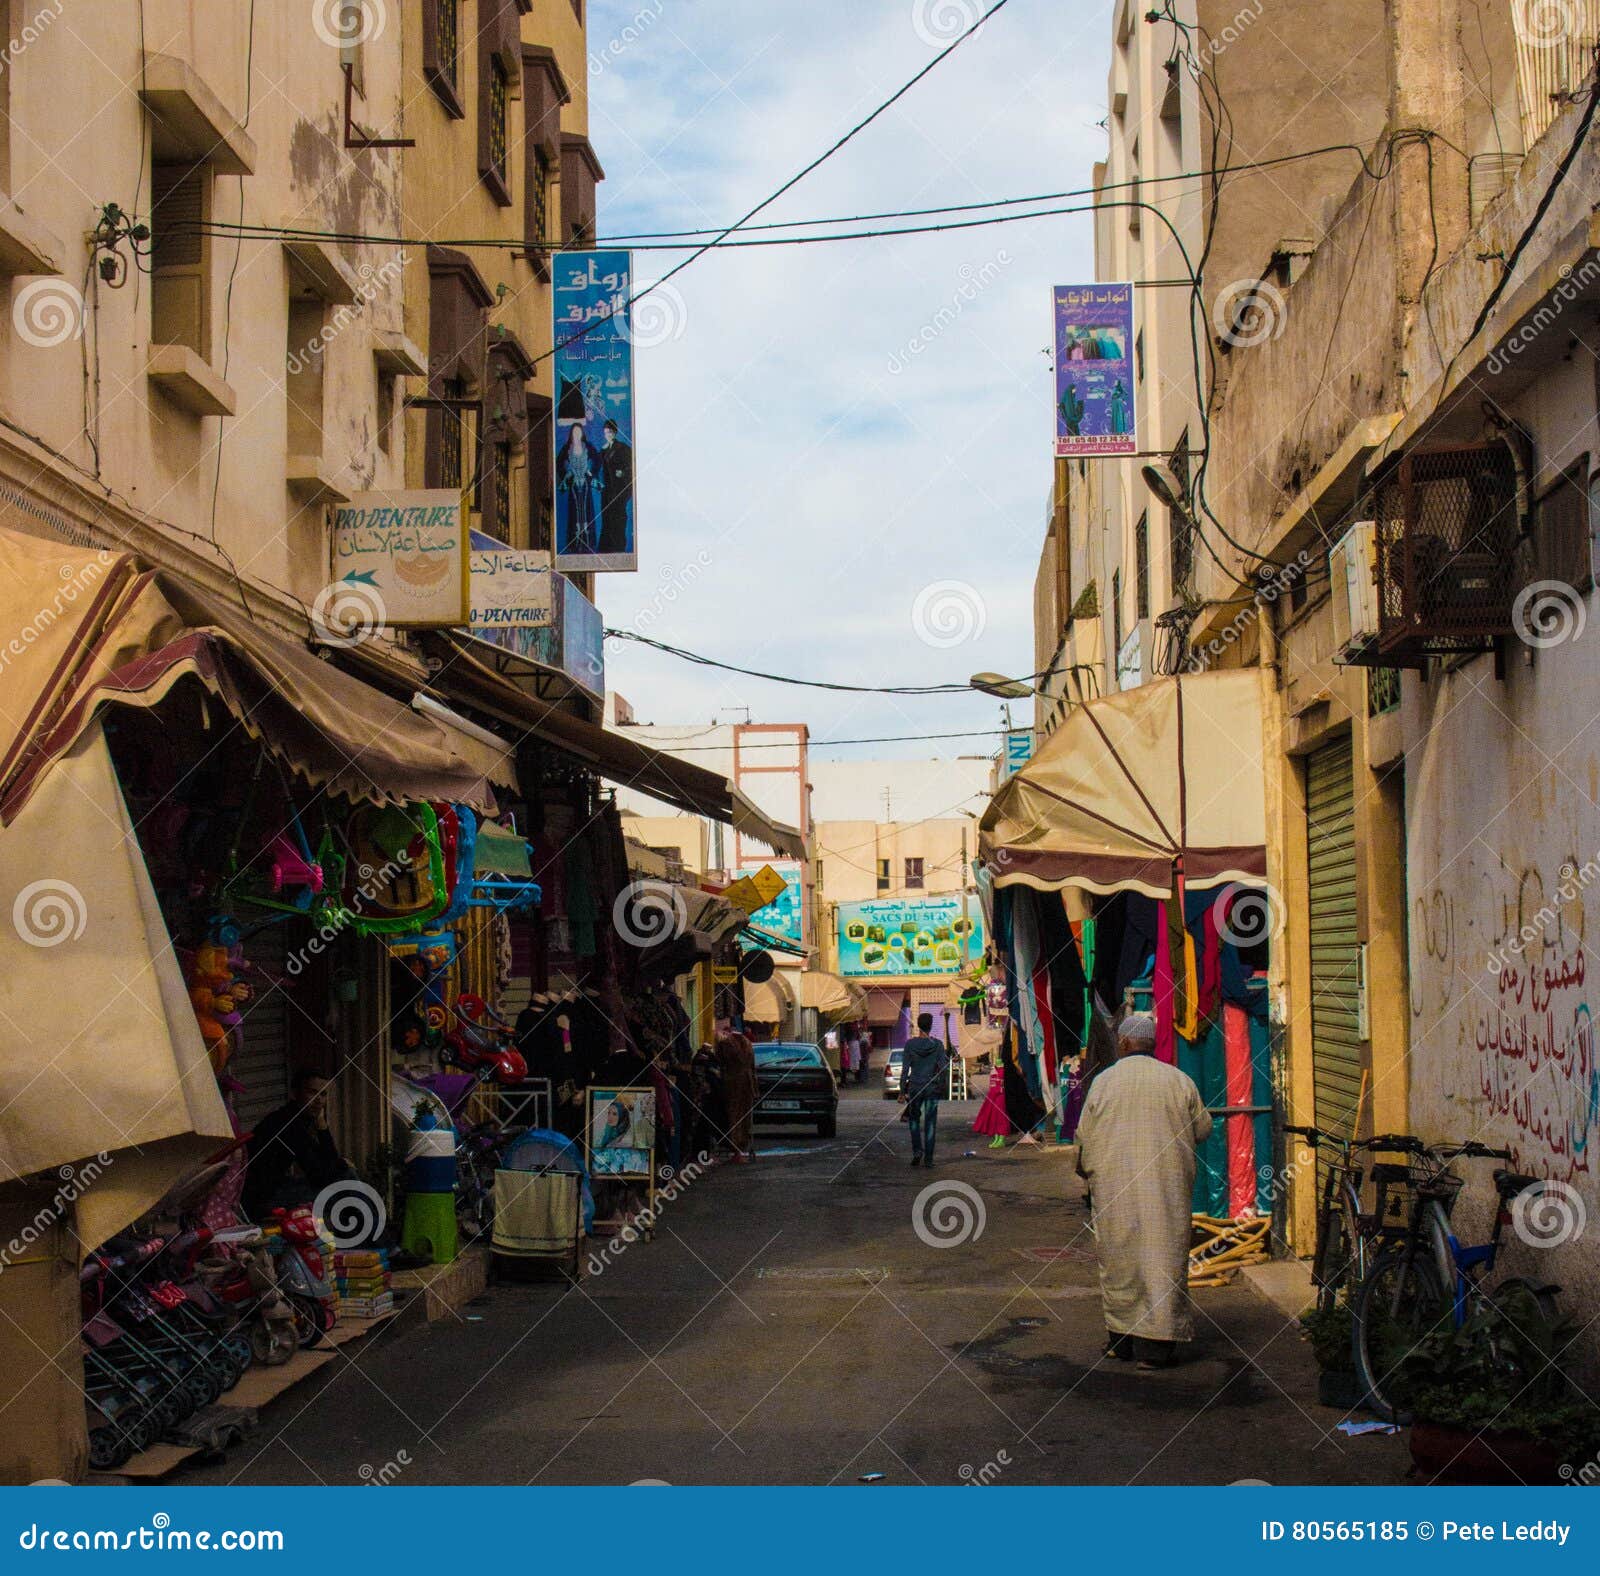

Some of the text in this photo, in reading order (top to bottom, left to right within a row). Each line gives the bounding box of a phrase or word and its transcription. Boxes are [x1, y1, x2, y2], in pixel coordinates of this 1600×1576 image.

[334, 504, 459, 530] PRO-DENTAIRE
[470, 607, 549, 623] O-DENTAIRE
[860, 900, 906, 914] الجنوب
[872, 912, 901, 923] SACS
[1531, 948, 1585, 1013] ممنوع
